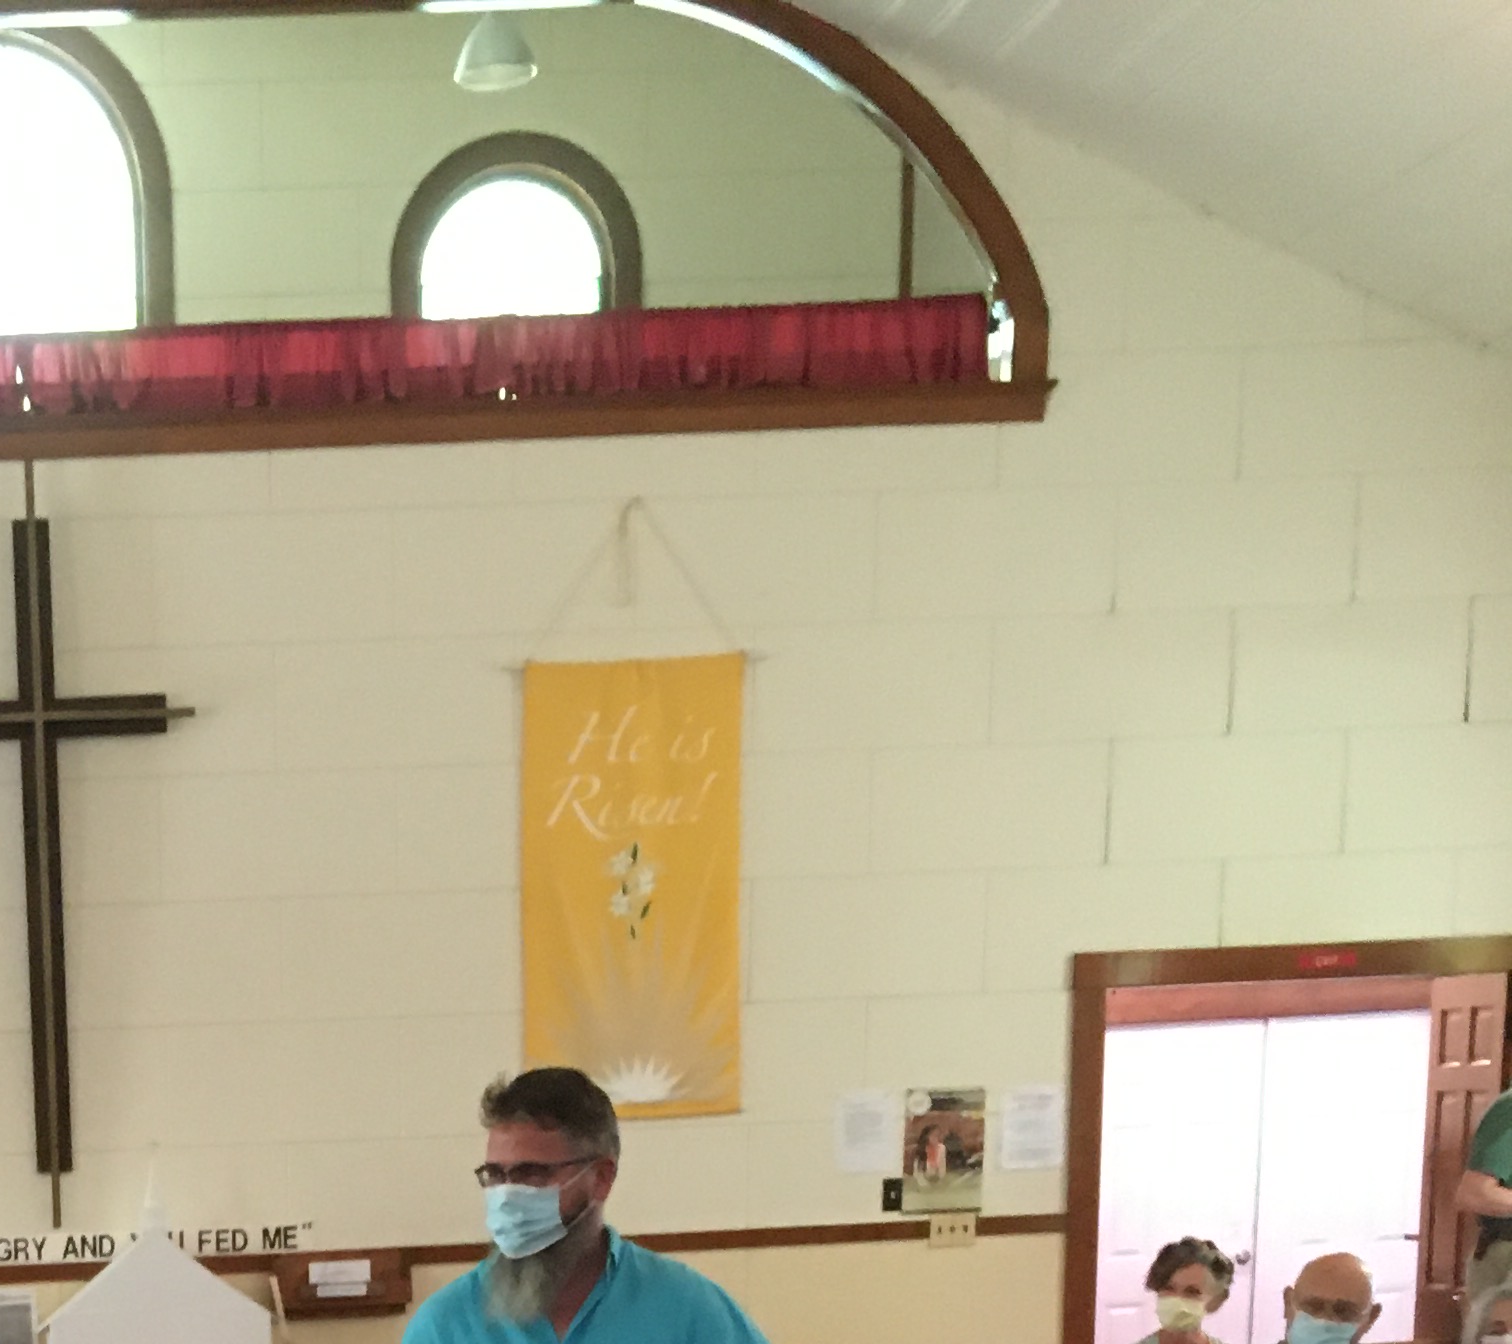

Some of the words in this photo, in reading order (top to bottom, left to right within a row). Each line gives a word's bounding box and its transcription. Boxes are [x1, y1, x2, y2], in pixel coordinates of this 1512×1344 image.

[567, 703, 652, 765] He
[668, 714, 718, 764] is
[545, 771, 719, 842] Risen!
[62, 1233, 116, 1260] AND
[197, 1227, 249, 1254] FED
